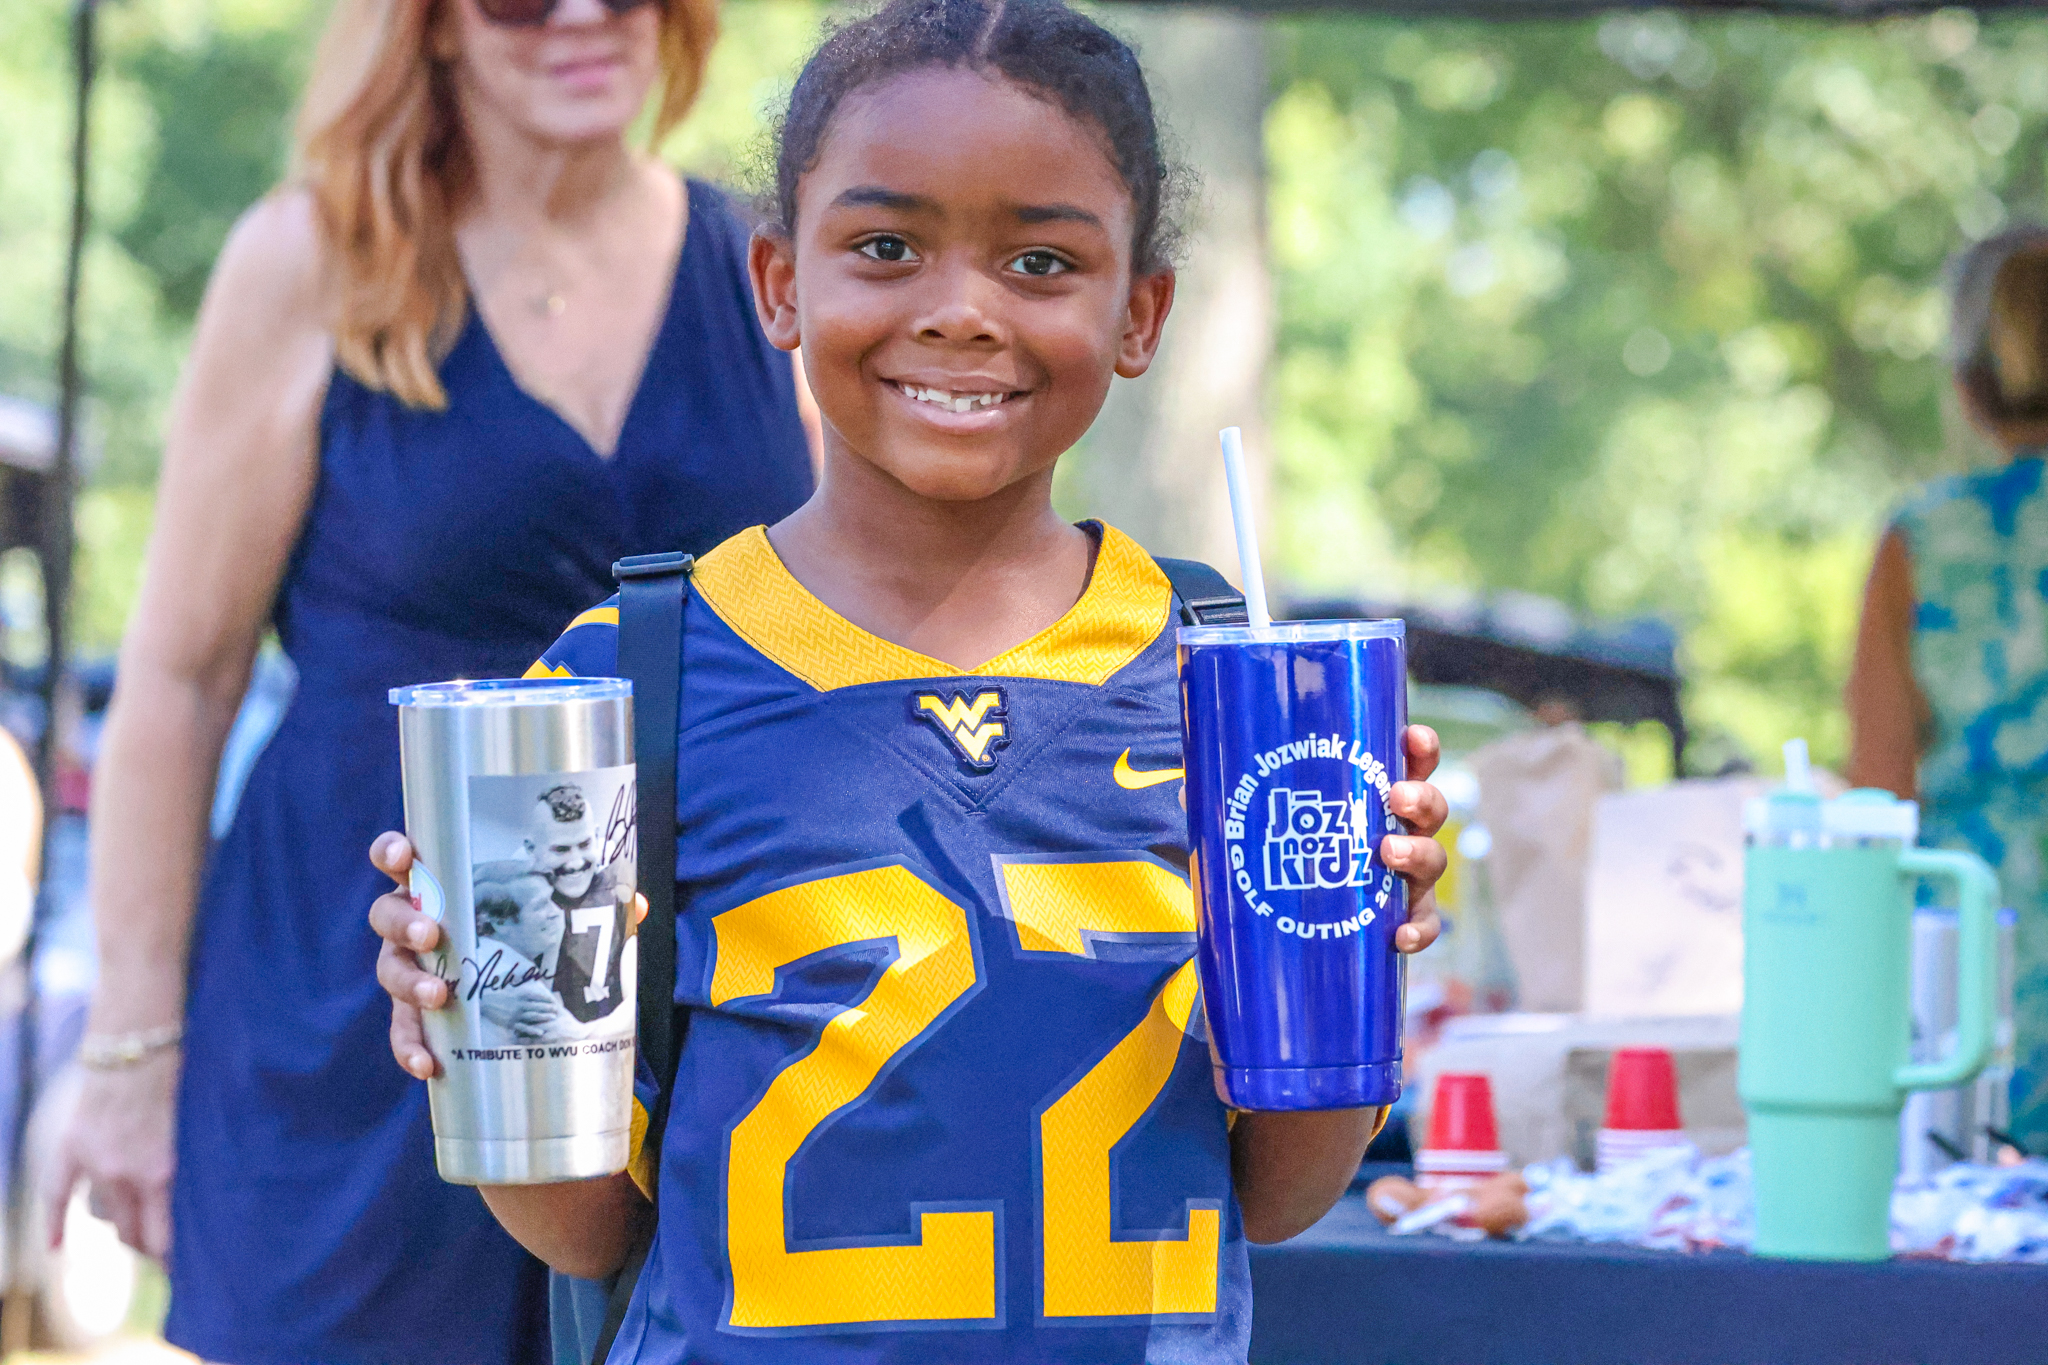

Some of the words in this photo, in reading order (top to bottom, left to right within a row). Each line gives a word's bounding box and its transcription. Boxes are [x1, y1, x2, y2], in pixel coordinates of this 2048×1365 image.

[1225, 773, 1259, 839] Brian
[1254, 733, 1346, 777] Jozwiak
[1231, 844, 1274, 917] GOLF
[1276, 907, 1376, 939] OUTING
[468, 1049, 522, 1060] TRIBUTE
[527, 1048, 545, 1059] TO
[549, 1046, 577, 1057] WVU
[583, 1041, 617, 1054] COACH
[711, 861, 1219, 1327] 22
